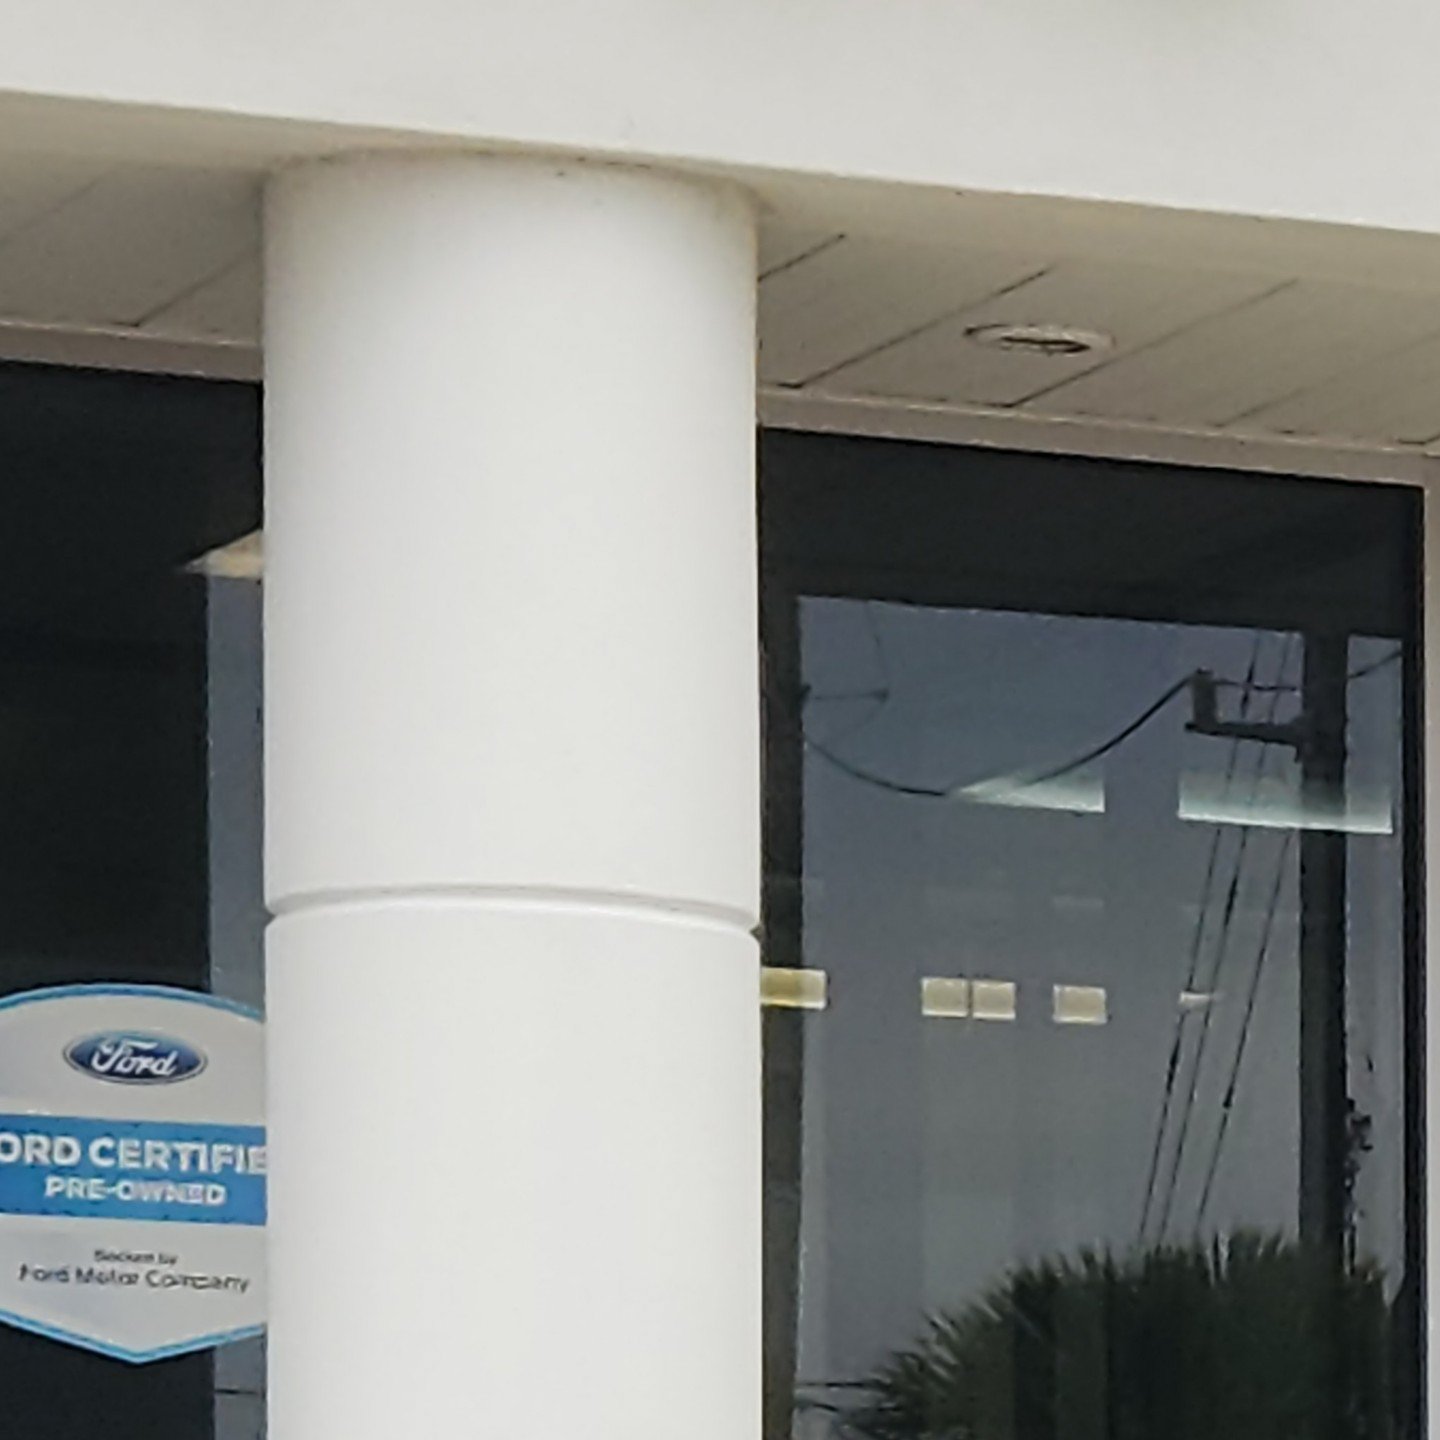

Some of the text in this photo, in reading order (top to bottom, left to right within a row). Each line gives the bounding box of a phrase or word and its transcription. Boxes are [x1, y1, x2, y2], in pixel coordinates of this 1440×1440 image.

[91, 1036, 177, 1077] Ford
[0, 1131, 267, 1175] ORD CERTIFIE
[45, 1175, 228, 1205] PRE-OWNED
[75, 1267, 140, 1286] Motor
[145, 1270, 249, 1294] Company
